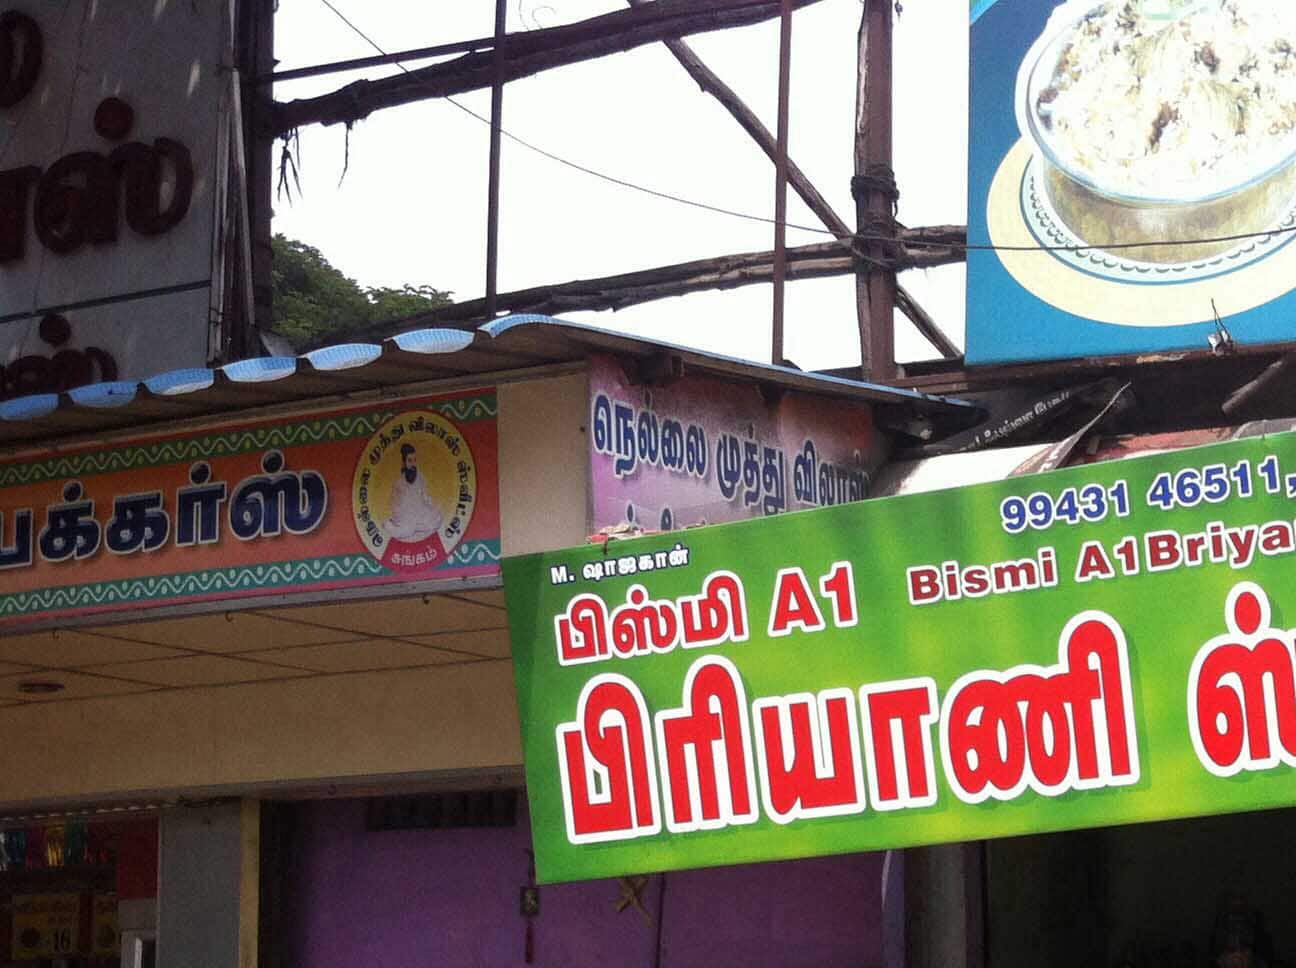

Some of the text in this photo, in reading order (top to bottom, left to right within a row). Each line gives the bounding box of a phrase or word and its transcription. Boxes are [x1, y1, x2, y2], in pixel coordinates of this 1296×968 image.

[592, 390, 707, 479] நெல்லை
[715, 422, 786, 515] முத்து
[1001, 481, 1129, 532] 99431
[551, 544, 690, 585] M. ஷாஜகான்
[907, 547, 1057, 605] Bismi
[554, 561, 859, 666] பிஸ்மி A1
[555, 610, 1141, 845] பிரியாணி
